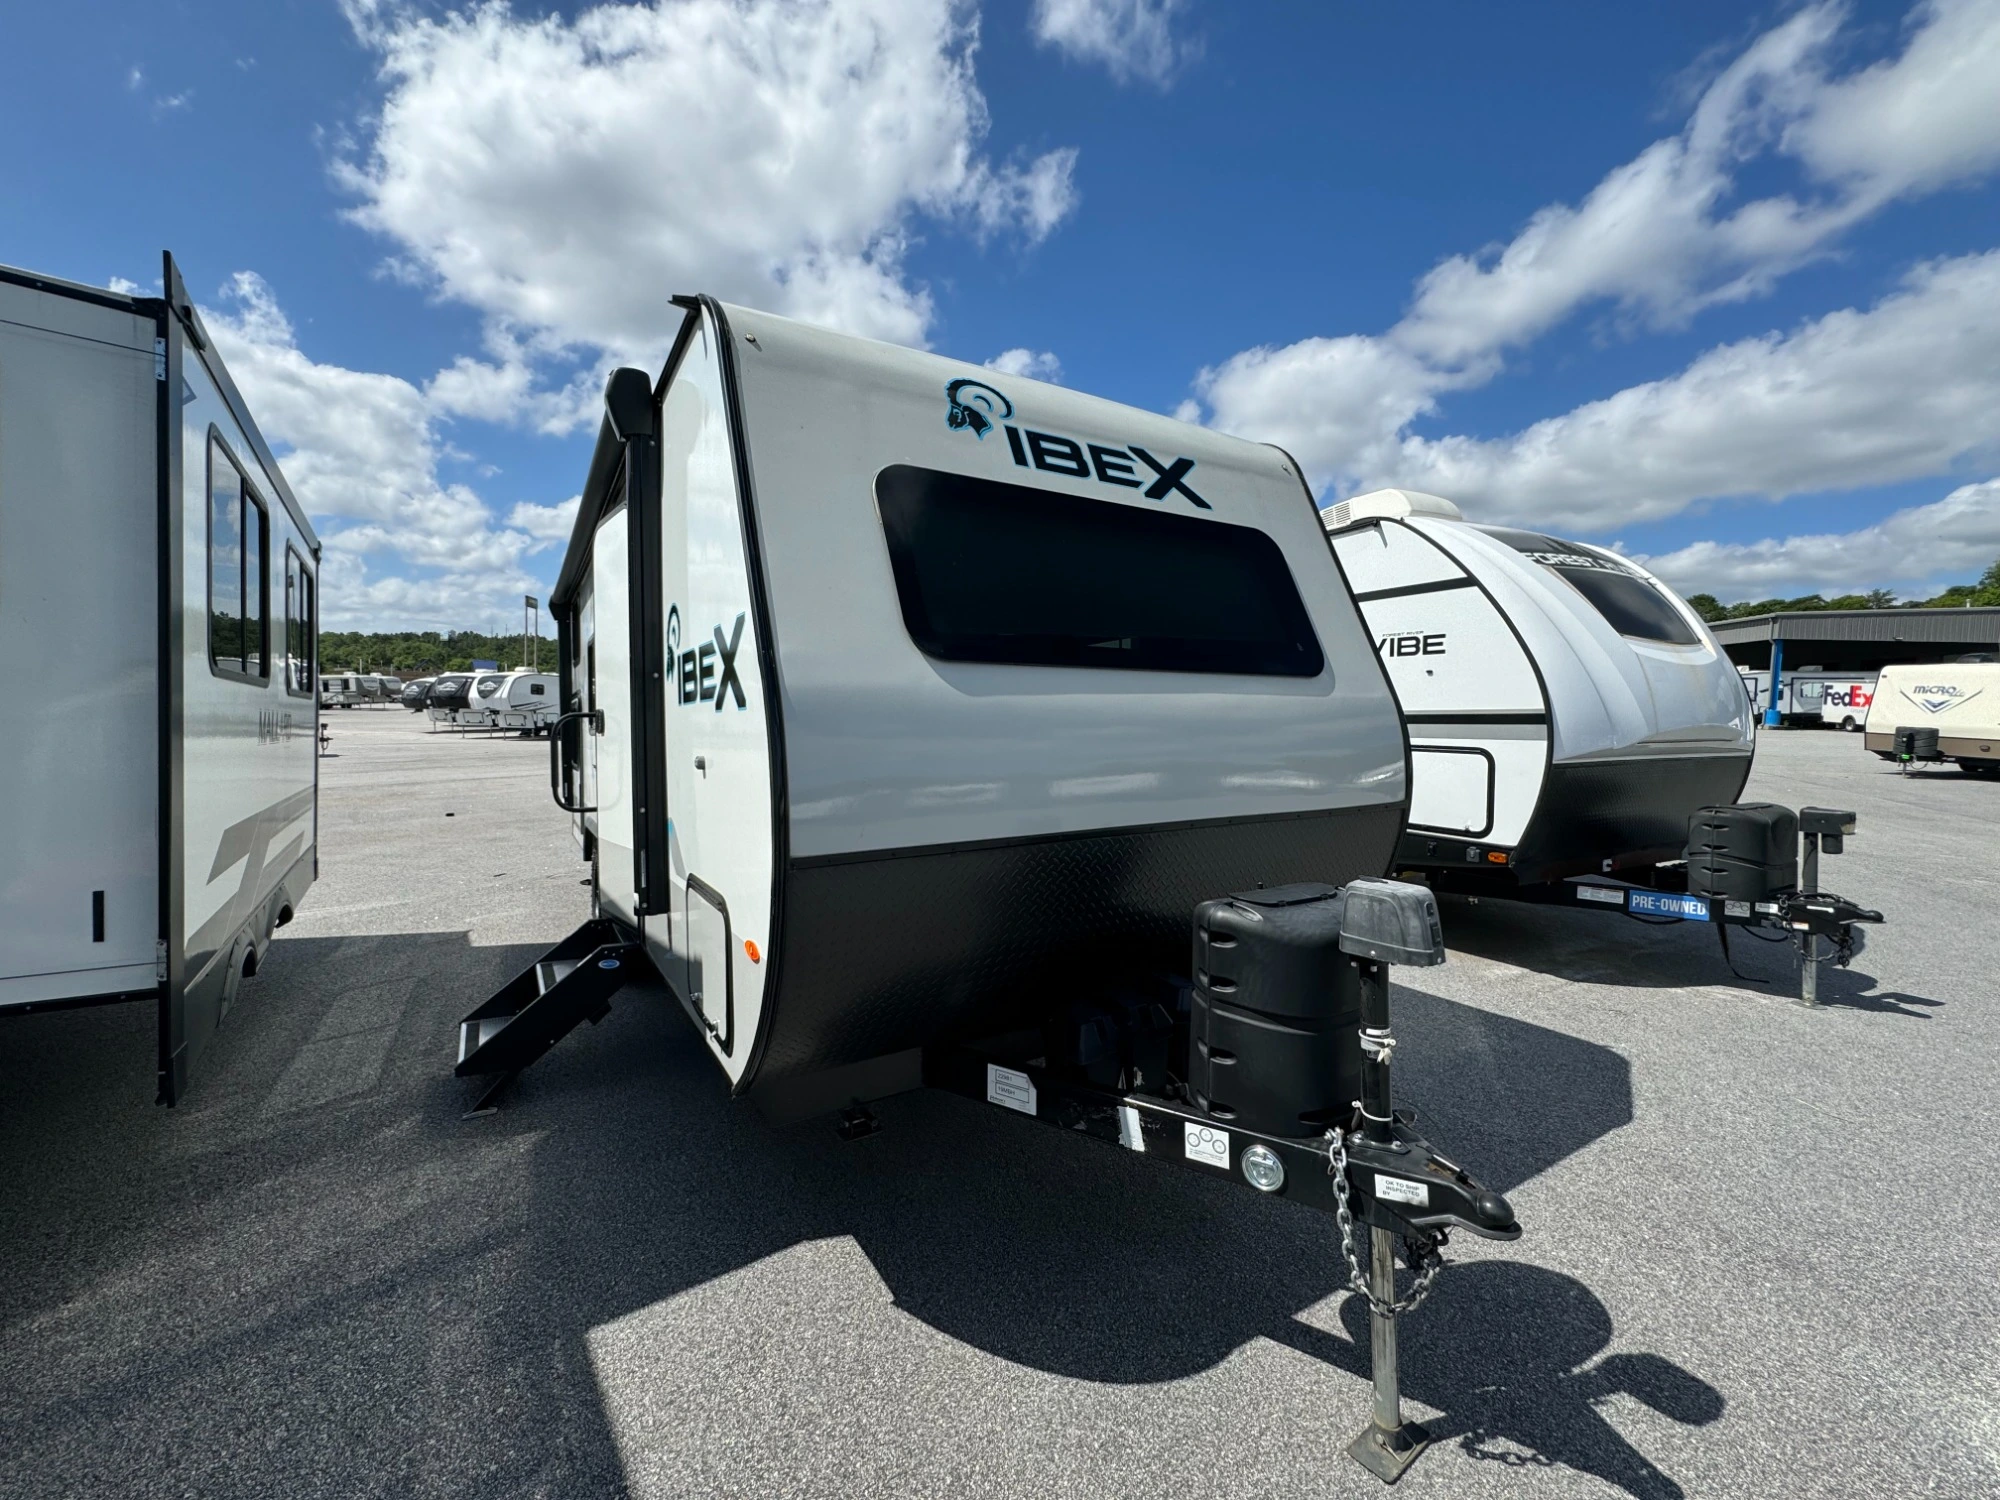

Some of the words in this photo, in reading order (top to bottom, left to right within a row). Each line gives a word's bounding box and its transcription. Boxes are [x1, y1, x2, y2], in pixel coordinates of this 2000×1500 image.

[1003, 424, 1213, 510] IBEX
[1522, 552, 1600, 568] FOREST
[678, 611, 747, 713] IBEX
[1823, 684, 1873, 708] FedEx
[1632, 895, 1707, 916] PRE-OWNED
[1385, 1186, 1420, 1197] INSPECTED
